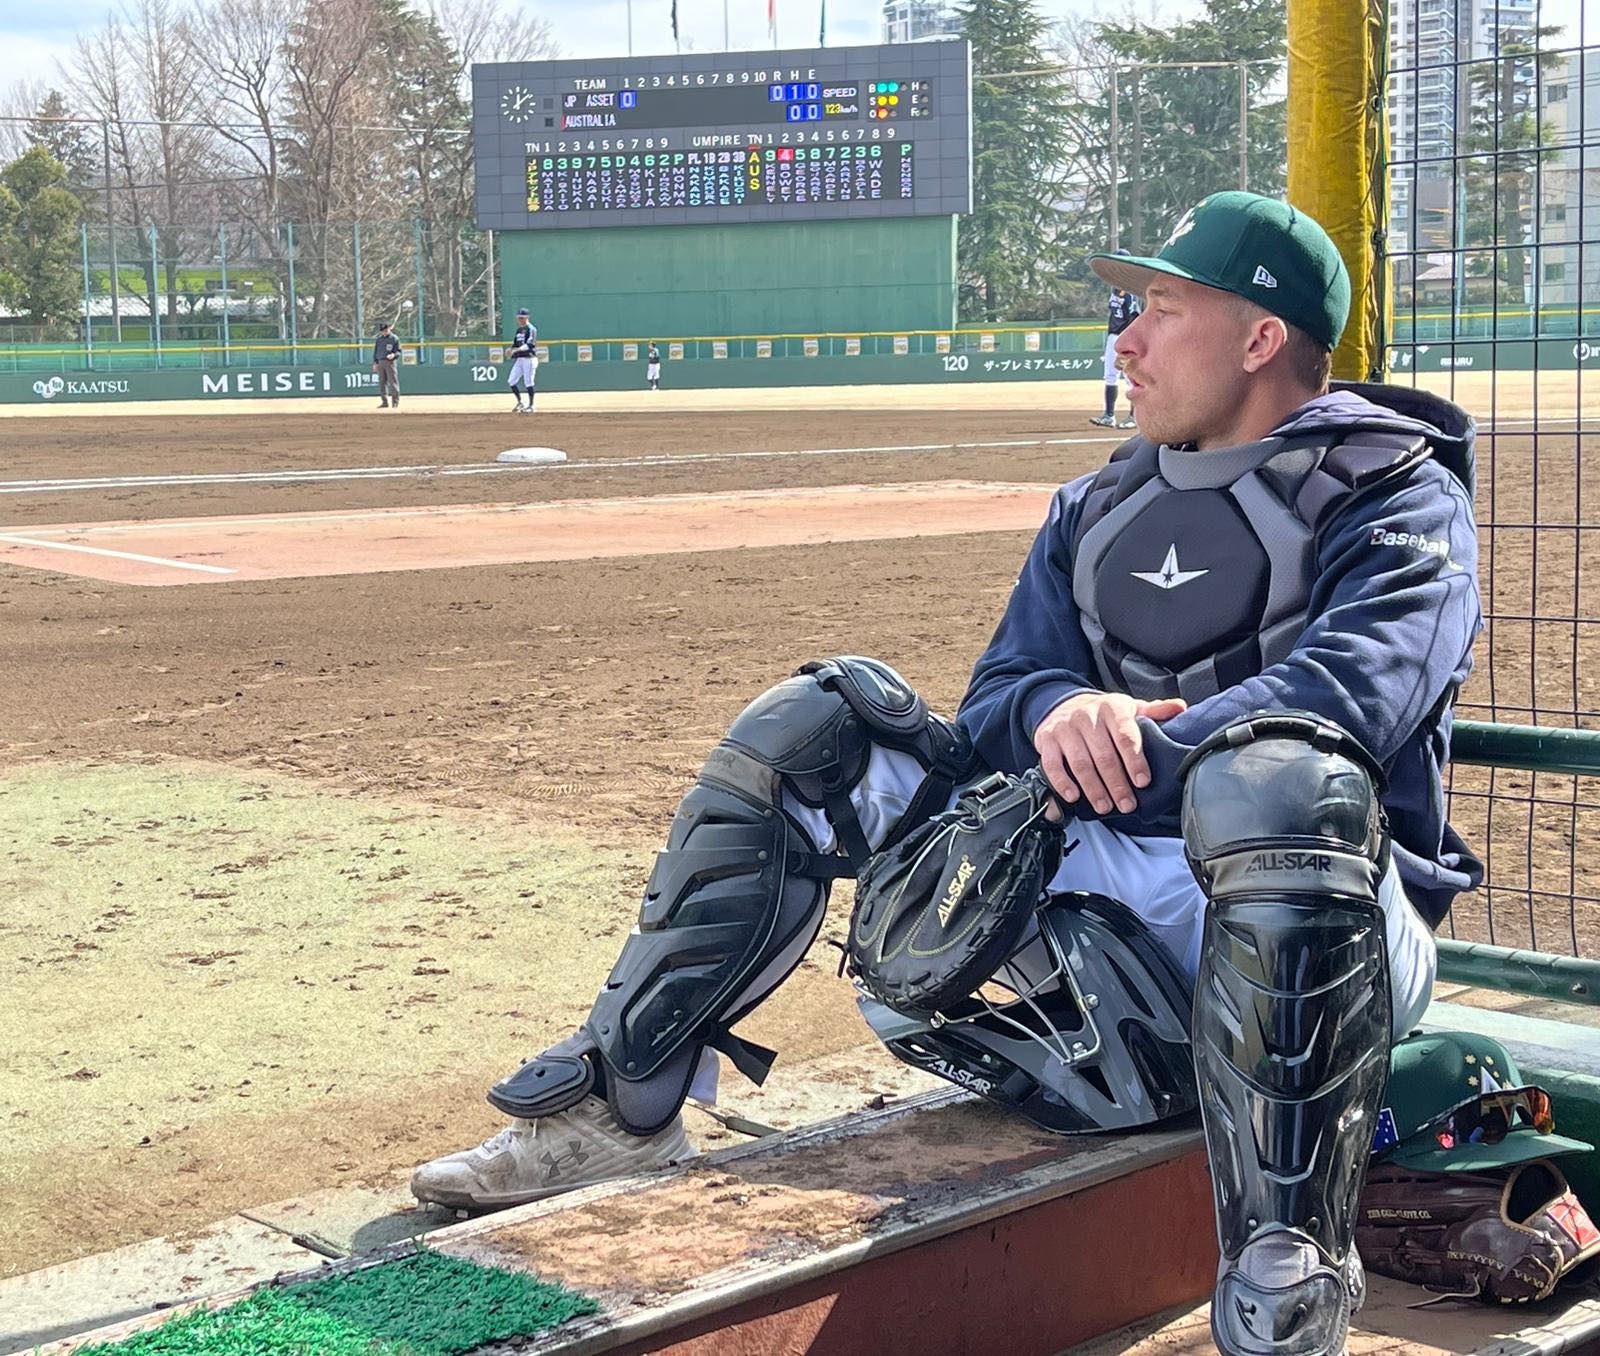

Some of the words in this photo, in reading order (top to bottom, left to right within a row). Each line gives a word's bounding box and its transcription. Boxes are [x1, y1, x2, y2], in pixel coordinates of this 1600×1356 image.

[574, 79, 606, 90] TEAM
[623, 77, 630, 88] 1
[638, 77, 645, 87] 2
[653, 76, 660, 87] 3
[667, 76, 675, 86] 4
[682, 75, 690, 85] 5
[697, 74, 704, 85] 6
[712, 74, 719, 84] 7
[726, 73, 734, 84] 8
[741, 72, 749, 83] 9
[754, 71, 767, 82] 10
[773, 71, 782, 81] R
[790, 70, 799, 80] H
[808, 69, 816, 80] E
[869, 83, 876, 93] B
[911, 81, 919, 91] H
[564, 94, 577, 108] JP
[586, 93, 615, 107] ASSET
[623, 92, 632, 107] 0
[773, 85, 783, 101] 0
[791, 84, 798, 100] 1
[808, 84, 818, 99] 0
[823, 87, 857, 98] SPEED
[869, 97, 876, 106] S
[912, 94, 918, 104] E
[565, 113, 616, 128] AUSTRALIA
[790, 105, 800, 120] 0
[808, 104, 818, 120] 0
[525, 142, 540, 153] TN
[544, 142, 550, 152] 1
[558, 142, 566, 152] 2
[573, 141, 580, 151] 3
[587, 140, 595, 150] 4
[602, 140, 610, 150] 5
[616, 139, 624, 150] 6
[631, 139, 639, 149] 7
[646, 138, 653, 148] 8
[660, 137, 668, 148] 9
[692, 135, 741, 147] UMPIRE
[747, 134, 762, 144] TN
[767, 133, 773, 144] 1
[781, 132, 789, 143] 2
[796, 132, 804, 142] 3
[811, 131, 819, 142] 4
[827, 130, 834, 141] 5
[841, 130, 850, 140] 6
[857, 129, 865, 139] 7
[872, 128, 880, 139] 8
[887, 128, 895, 138] 9
[543, 158, 553, 170] 8
[557, 158, 567, 169] 3
[571, 157, 582, 169] 9
[586, 157, 596, 168] 7
[601, 156, 611, 168] 5
[615, 156, 626, 167] D
[630, 155, 640, 166] 4
[644, 155, 655, 166] 6
[659, 154, 670, 165] 2
[674, 153, 684, 165] P
[688, 153, 701, 164] PL
[703, 152, 716, 164] 1B
[717, 151, 730, 163] 2B
[732, 151, 745, 163] 3B
[765, 150, 776, 161] 9
[795, 148, 806, 160] 5
[810, 148, 821, 159] 8
[825, 147, 836, 159] 7
[840, 146, 851, 158] 2
[855, 146, 866, 157] 3
[870, 145, 881, 157] 6
[901, 144, 912, 155] P
[748, 151, 760, 190] AUS
[868, 159, 883, 198] WADE
[542, 171, 554, 210] MATSUDA
[572, 171, 582, 210] INUKAI
[586, 170, 597, 208] NAGAI
[601, 169, 612, 208] SUZUKI
[644, 168, 655, 206] KITA
[673, 167, 685, 206] MONMA
[689, 167, 701, 206] NAKANO
[795, 162, 806, 202] GEORGE
[942, 355, 969, 371] 120
[202, 372, 331, 393] MEISEI
[471, 366, 497, 382] 120
[67, 380, 129, 394] KAATSU
[1245, 852, 1331, 873] ALL-STAR
[937, 861, 977, 928] ALL-STAR
[927, 1060, 991, 1095] ALL-STAR
